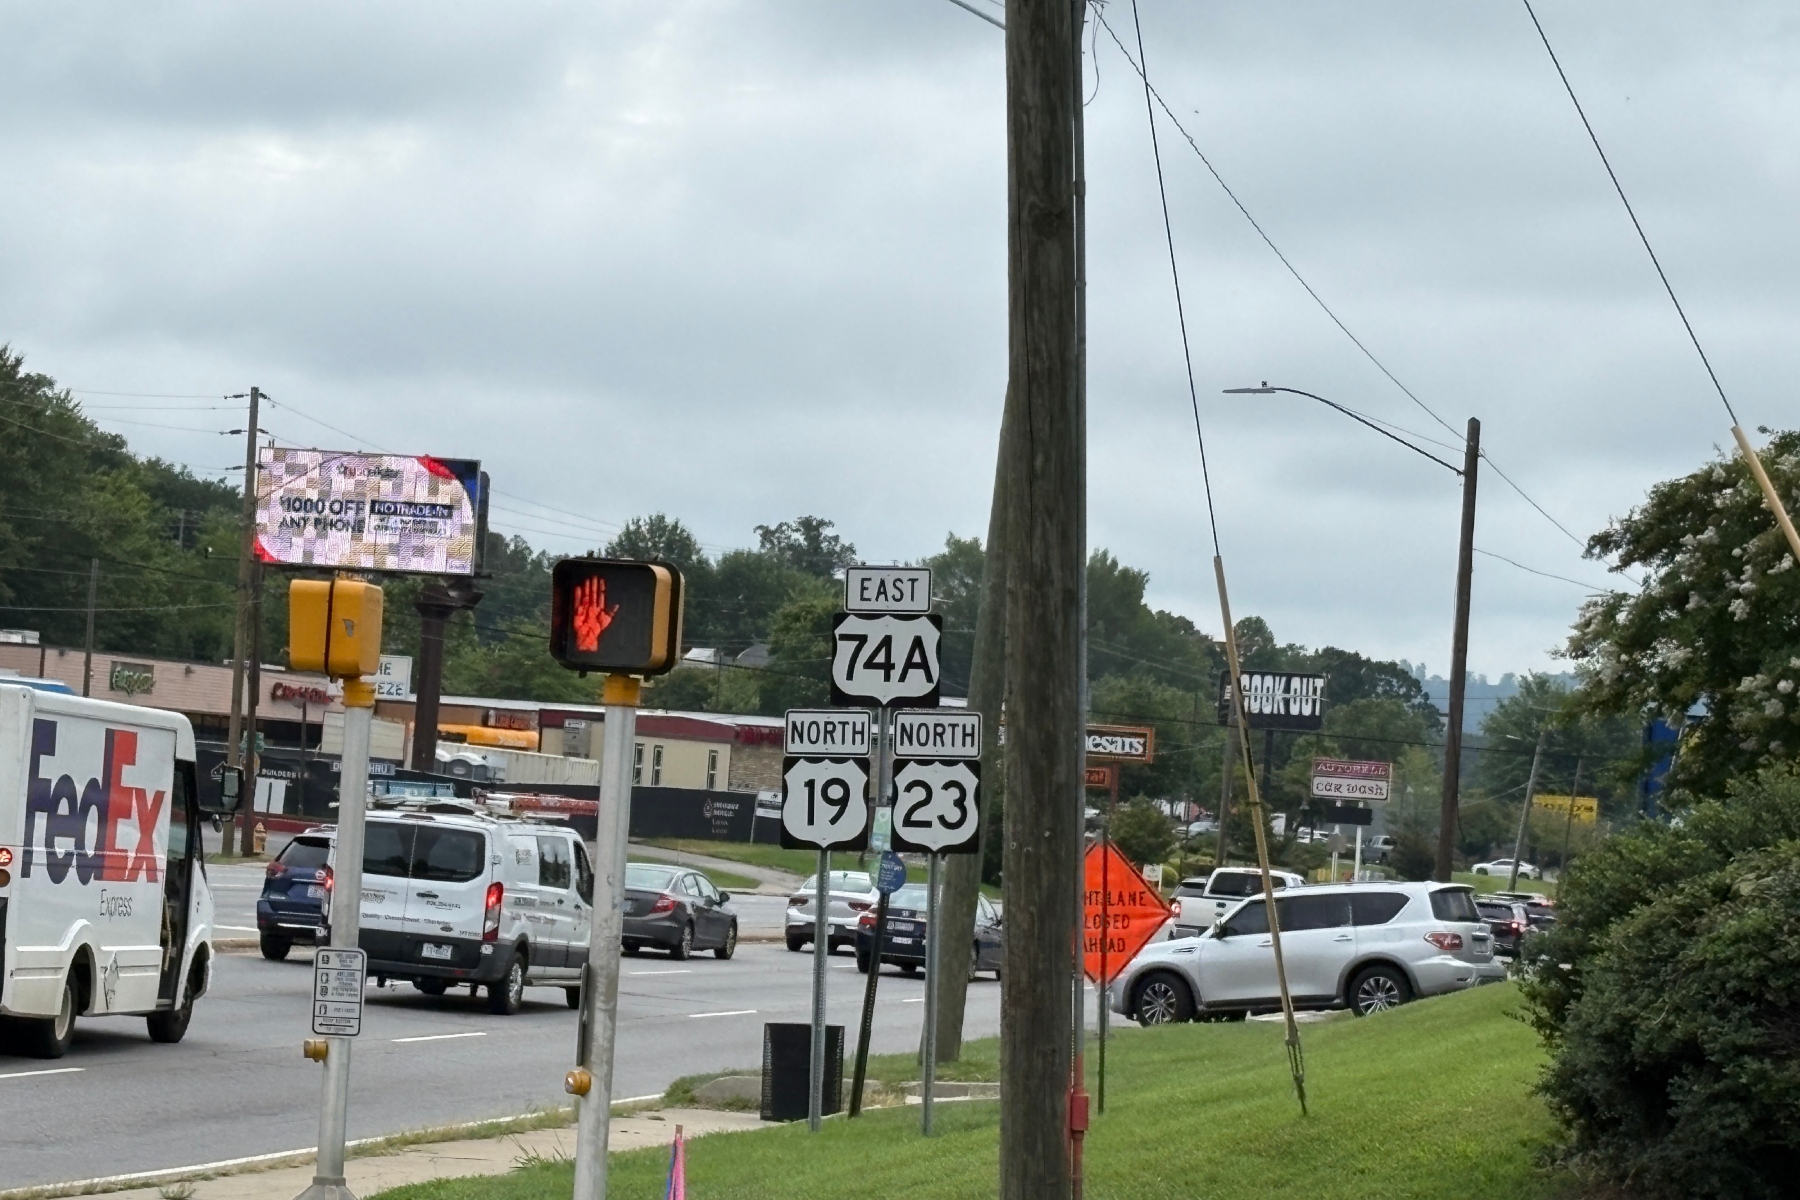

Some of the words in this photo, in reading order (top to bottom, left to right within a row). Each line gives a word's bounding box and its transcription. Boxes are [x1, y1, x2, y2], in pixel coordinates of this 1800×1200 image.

[859, 577, 919, 602] EAST
[838, 633, 935, 684] 74A
[1240, 674, 1287, 715] COOK
[1289, 676, 1324, 717] OUT
[790, 720, 866, 746] NORTH
[899, 722, 976, 748] NORTH
[20, 717, 167, 886] FedEx
[804, 777, 851, 827] 19
[901, 779, 968, 830] 23
[99, 889, 133, 921] Express
[1105, 890, 1147, 907] LANE
[1084, 914, 1130, 930] LOSED
